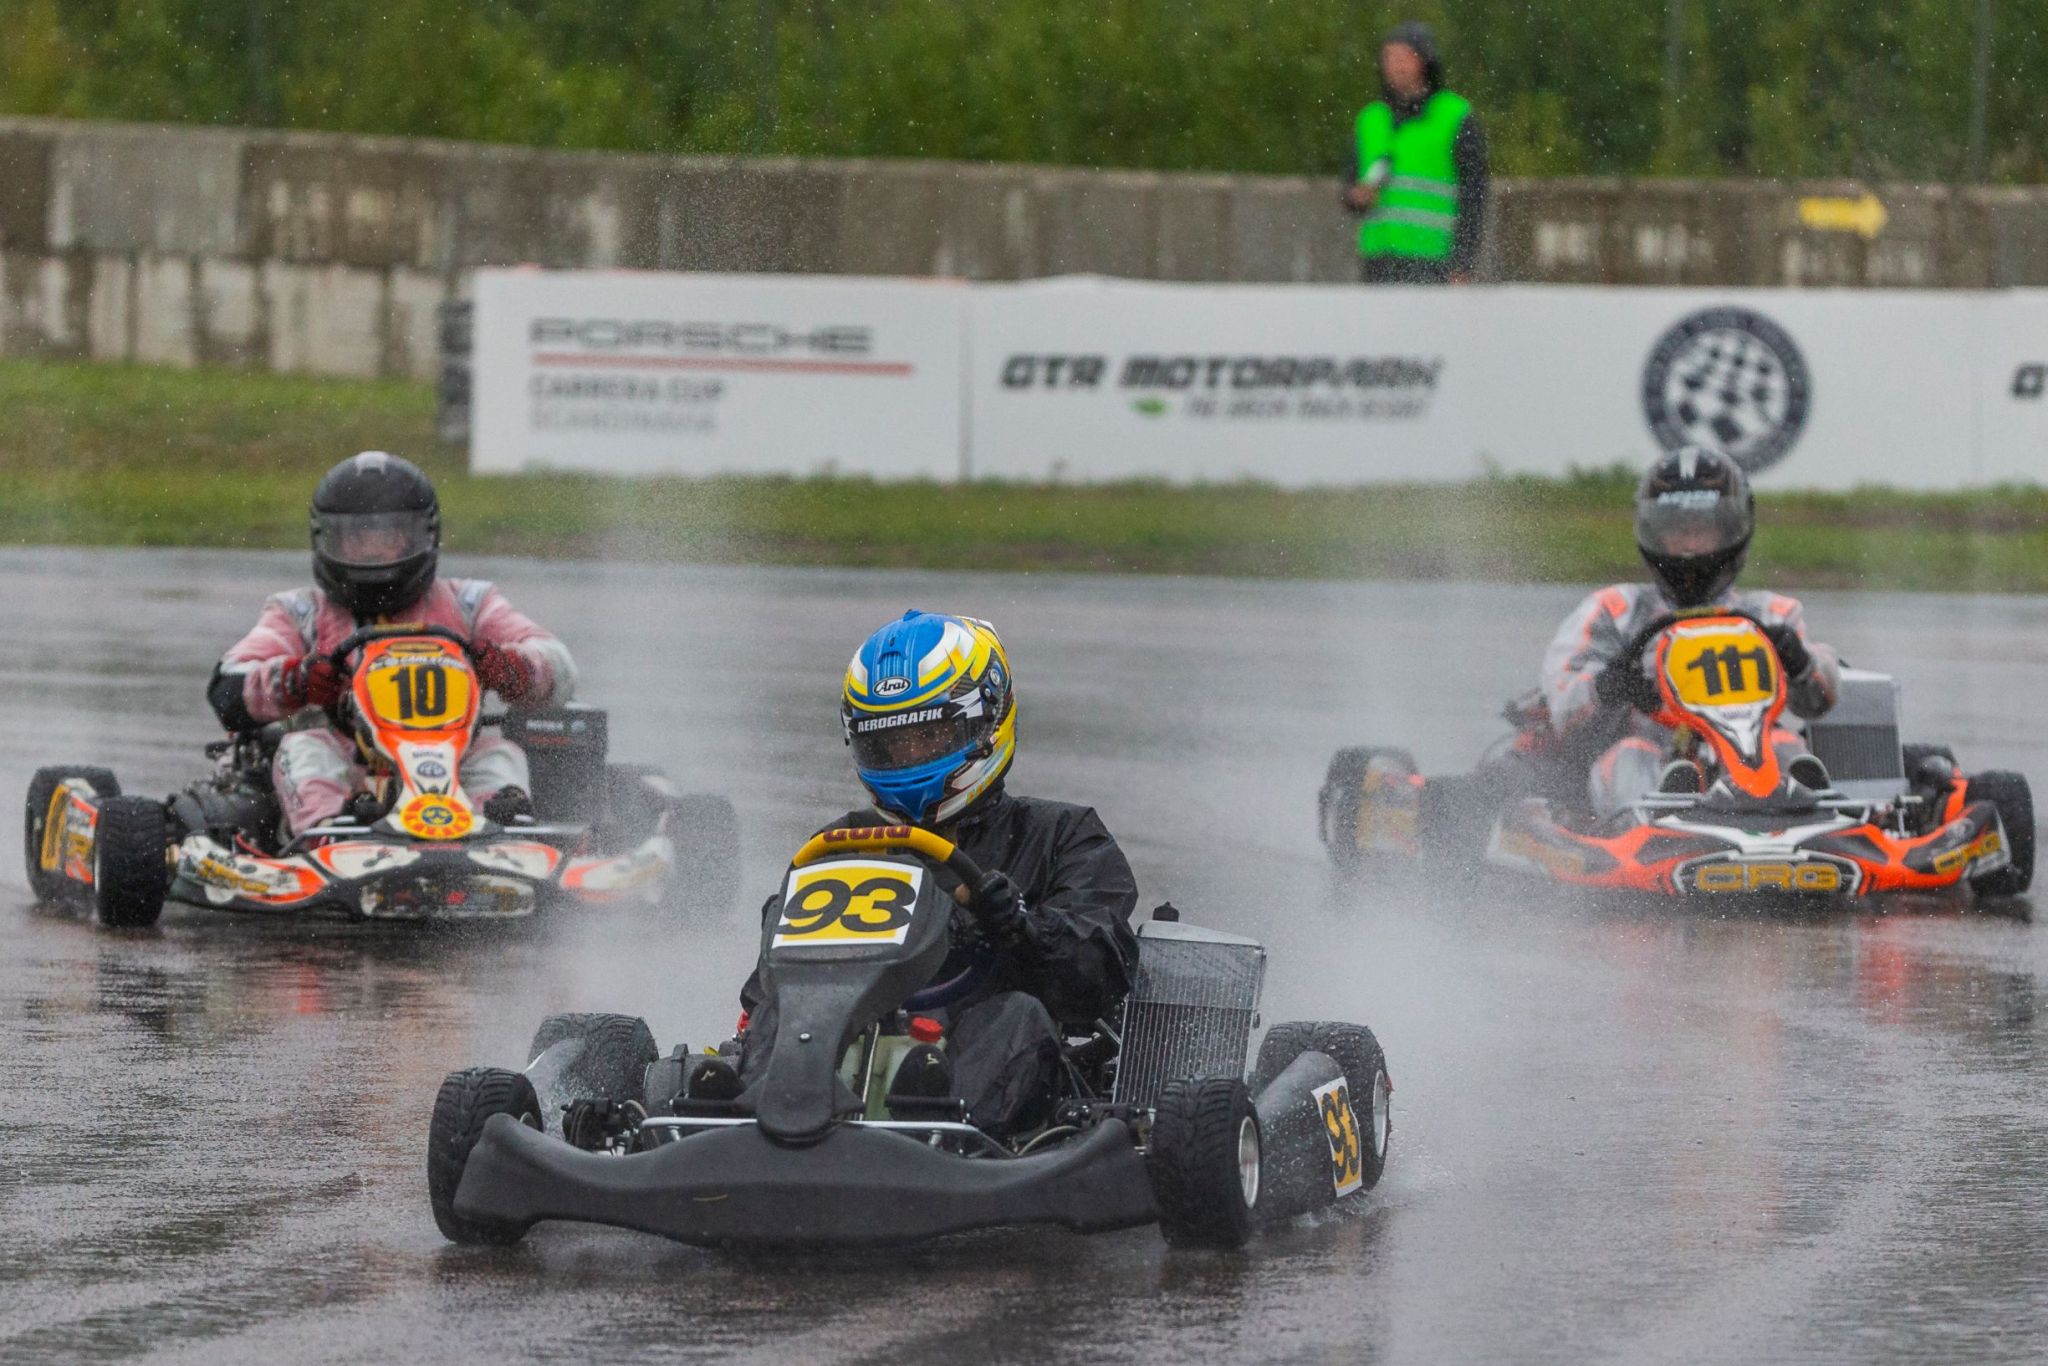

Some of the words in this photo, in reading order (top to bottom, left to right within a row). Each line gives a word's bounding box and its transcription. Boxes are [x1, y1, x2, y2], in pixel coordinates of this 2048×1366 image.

[529, 317, 872, 354] PORSCHE
[529, 376, 660, 402] CARRERA
[668, 377, 727, 403] CUP
[1001, 354, 1106, 389] GTR
[1118, 354, 1444, 391] MOTORPARK
[875, 679, 908, 694] Arai
[1687, 644, 1772, 696] 111
[389, 665, 447, 720] 10
[857, 707, 943, 732] AEROGRAFIK
[1697, 862, 1840, 892] CRG
[778, 876, 918, 935] 93
